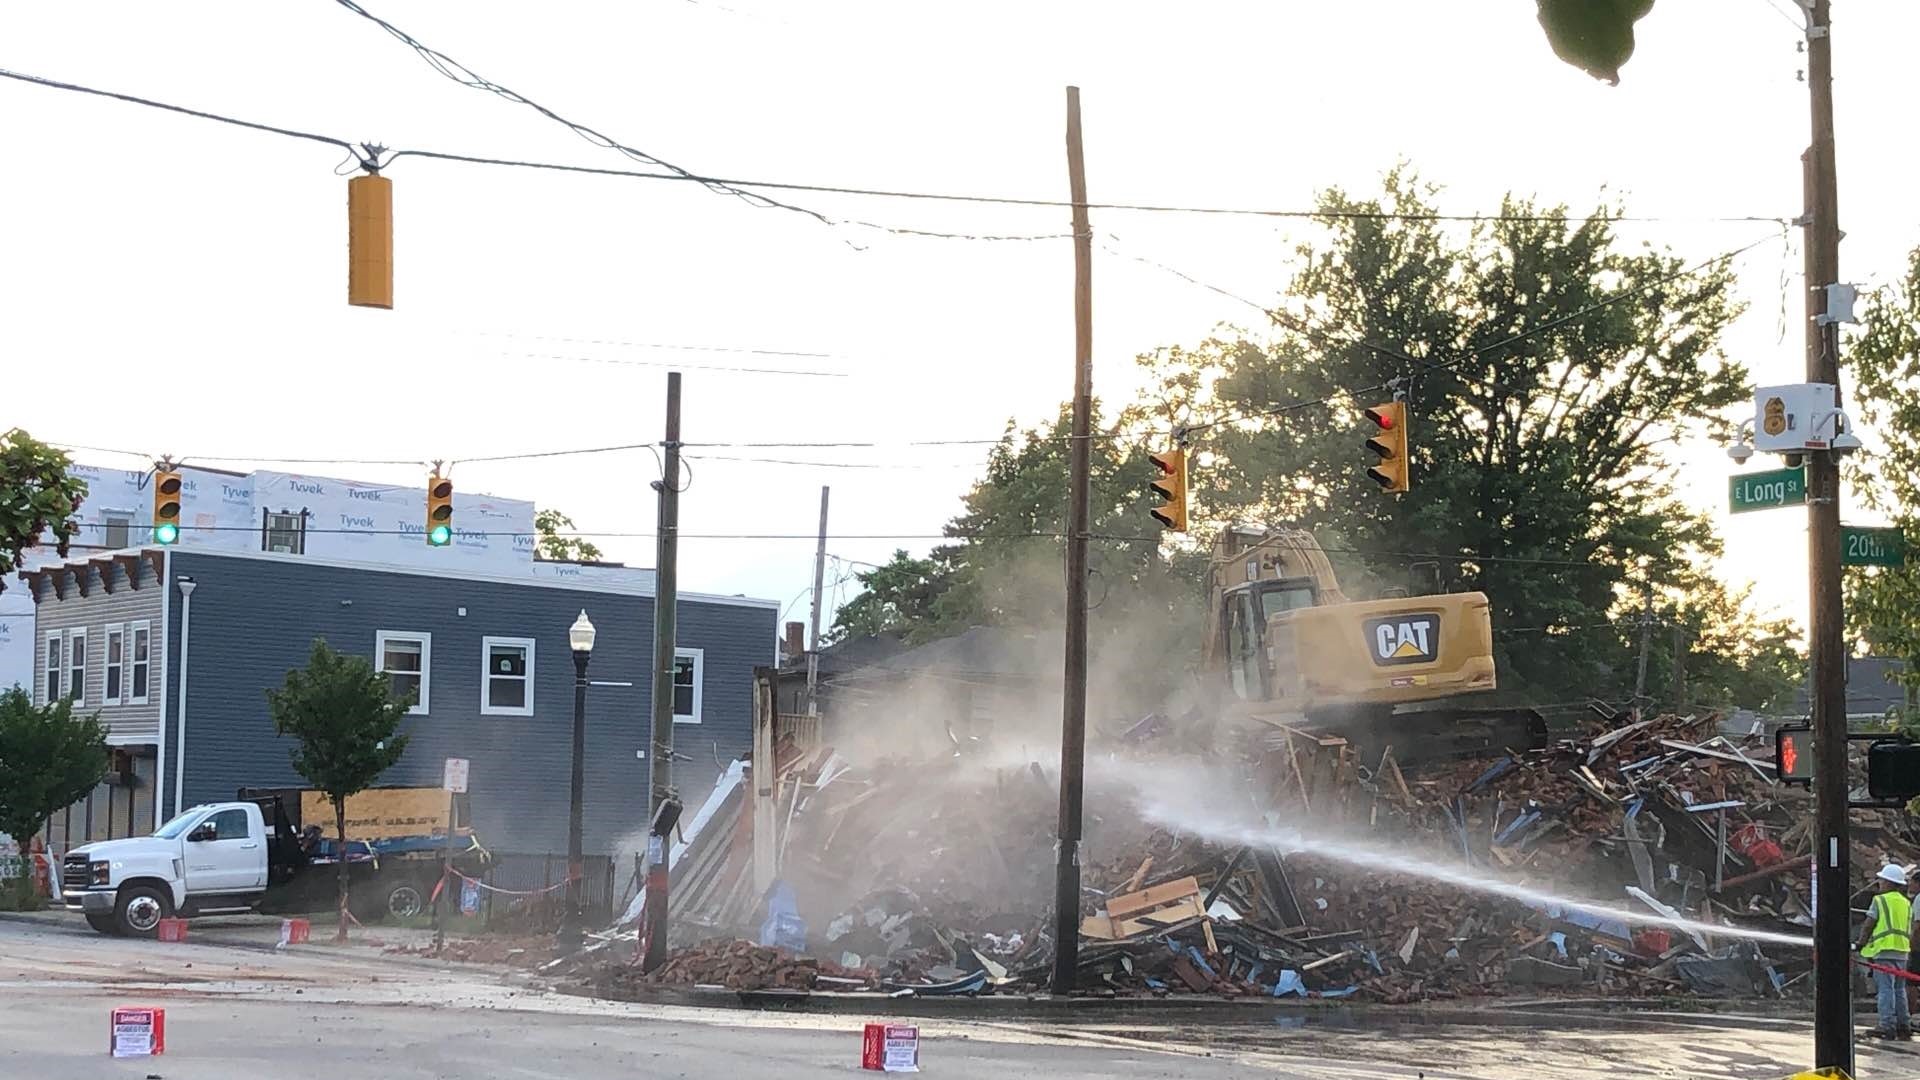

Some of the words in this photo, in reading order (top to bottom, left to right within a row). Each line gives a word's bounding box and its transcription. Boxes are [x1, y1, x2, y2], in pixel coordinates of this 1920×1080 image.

[222, 485, 249, 498] Tyve
[290, 480, 325, 495] Tyvek
[1735, 487, 1742, 499] E
[1744, 480, 1785, 505] Long
[1787, 480, 1797, 492] St
[340, 514, 375, 528] Tyvek
[398, 520, 425, 533] Tyve
[456, 527, 488, 541] Tyvek
[554, 566, 580, 577] Tyvek
[1376, 620, 1430, 659] CAT
